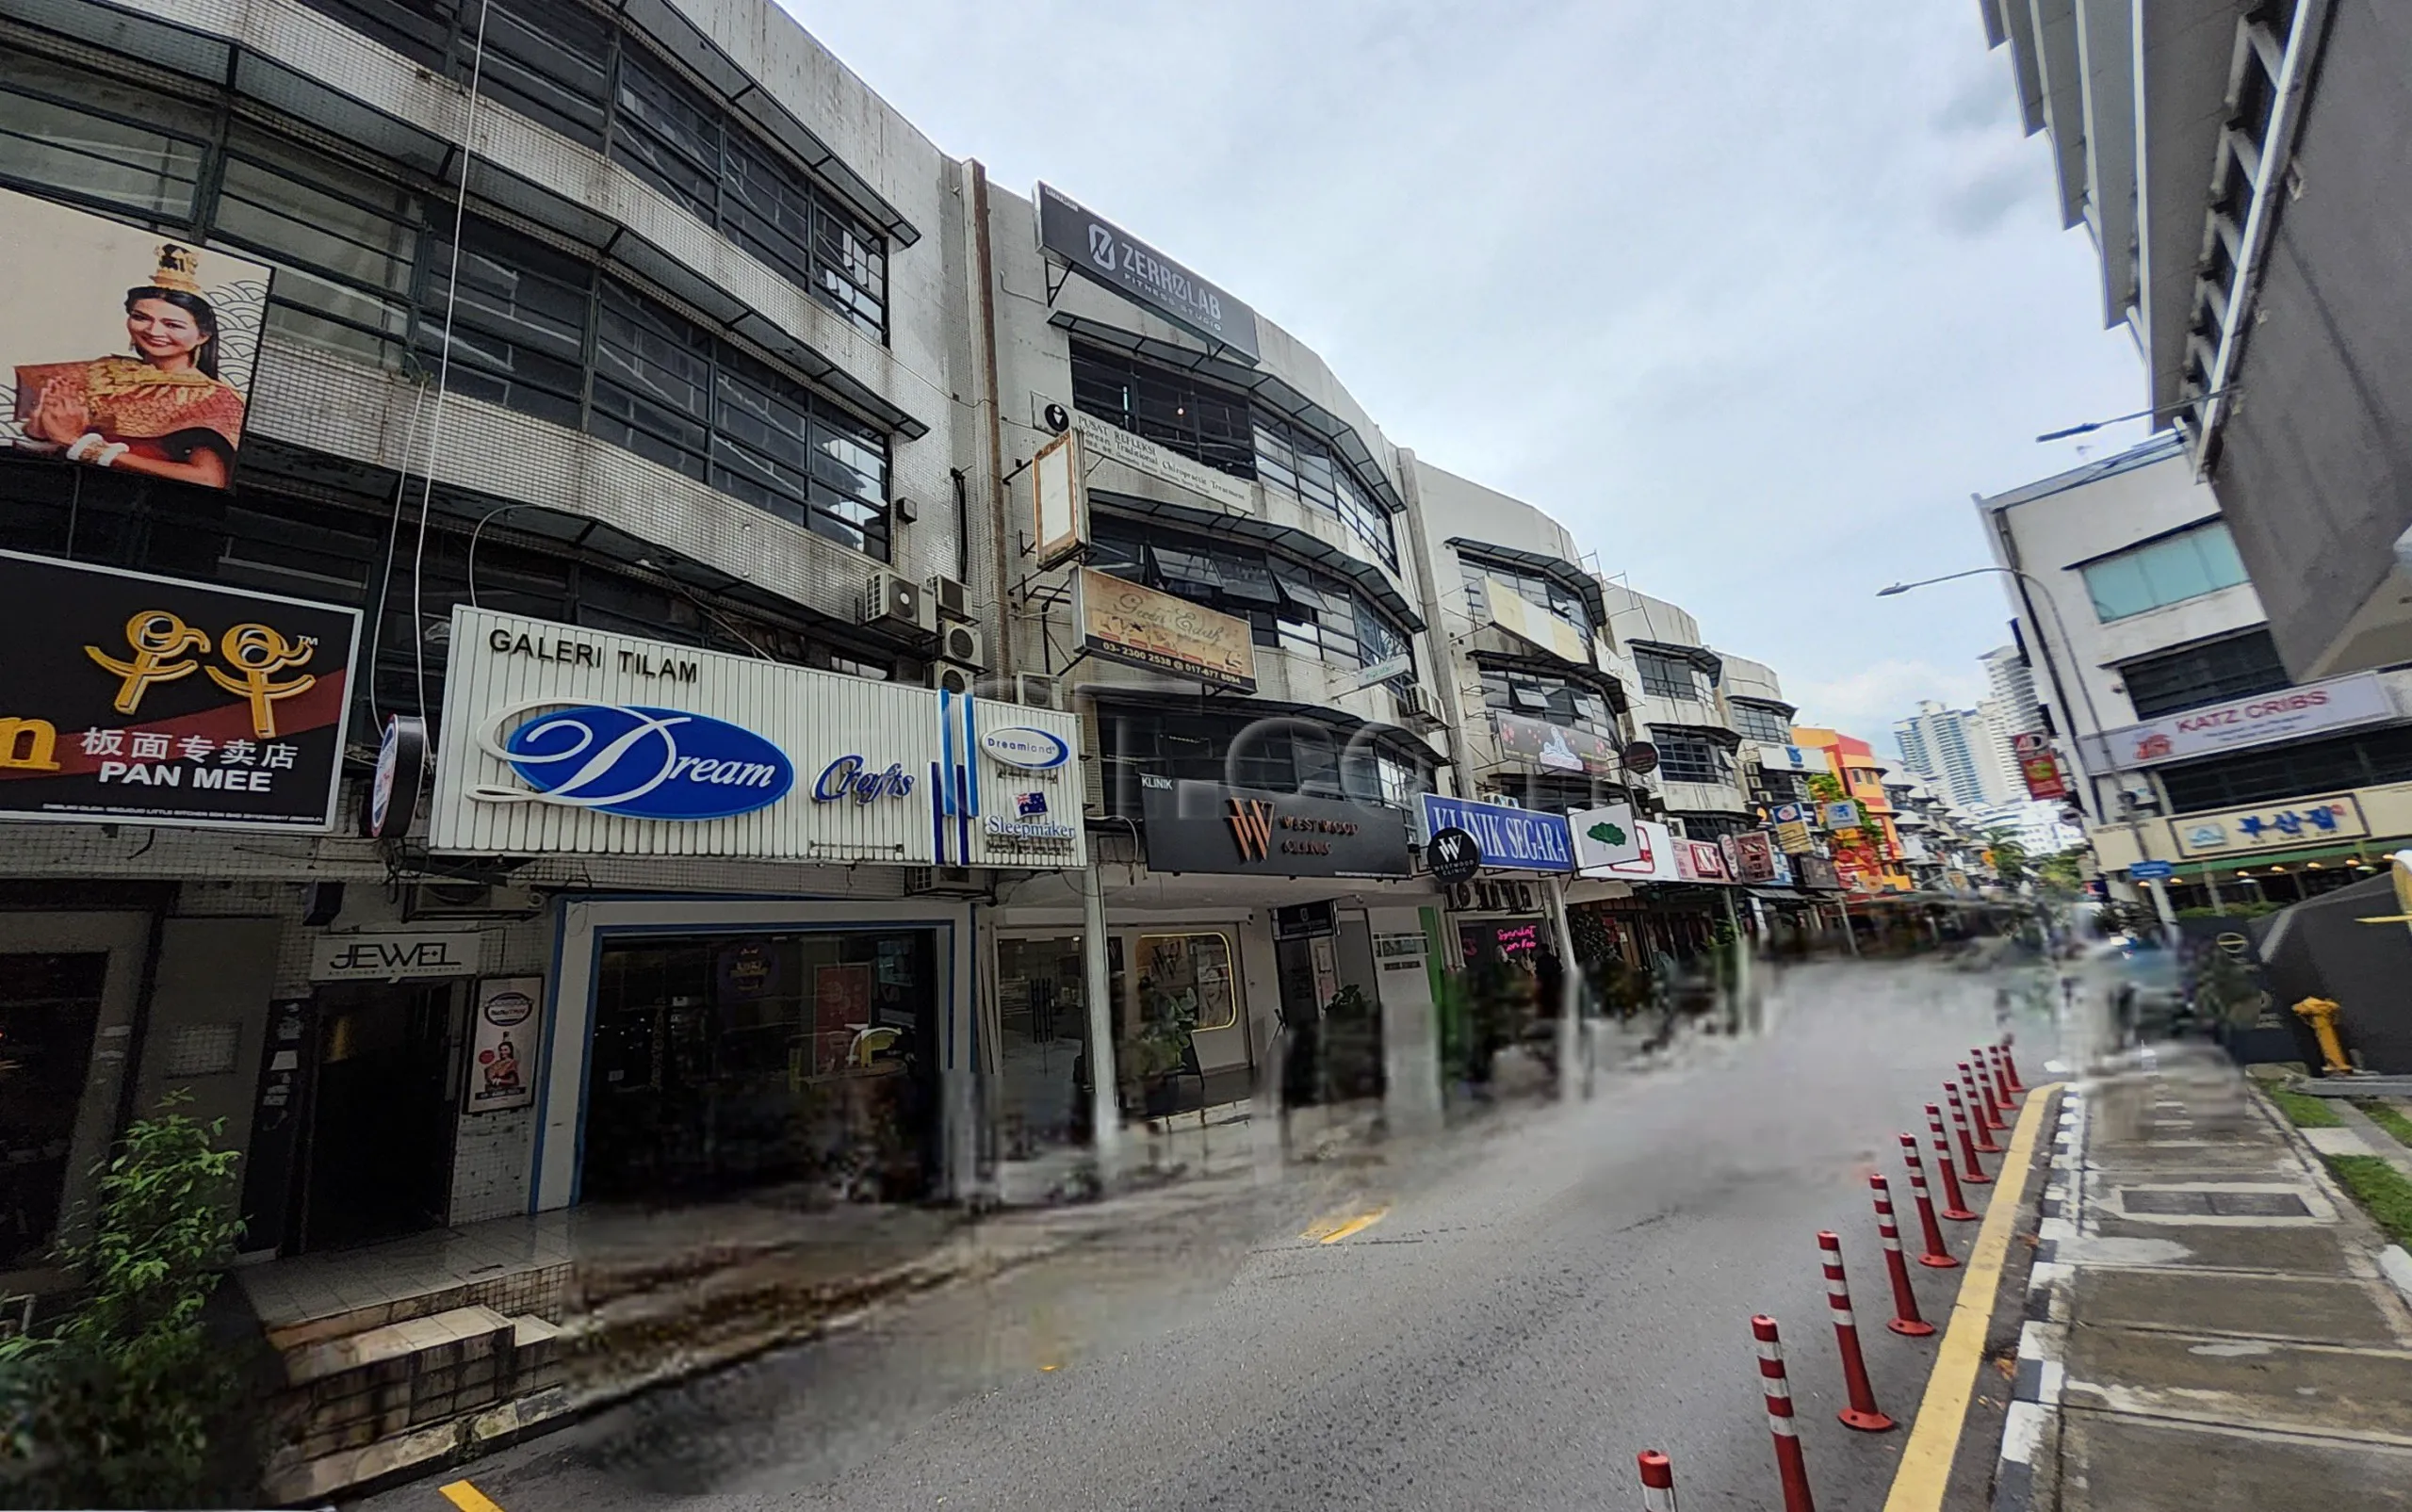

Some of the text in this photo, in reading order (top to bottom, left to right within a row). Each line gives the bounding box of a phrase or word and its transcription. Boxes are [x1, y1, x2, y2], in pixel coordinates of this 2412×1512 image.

[1124, 272, 1176, 306] FITNESS
[1180, 304, 1222, 331] STUDIO
[1077, 415, 1157, 456] PUSAT REFLEKSI
[1115, 438, 1159, 465] Traditional
[1162, 461, 1208, 485] Chiropractic
[1210, 480, 1246, 501] Treatment
[489, 627, 698, 684] GALERI TILAM
[1121, 646, 1146, 659] 2300
[2175, 709, 2243, 734] KATZ
[2243, 691, 2330, 719] CRIBS
[80, 726, 300, 770] 板面专卖店
[466, 697, 776, 807] Dream
[98, 760, 273, 793] PAN MEE
[810, 755, 915, 806] Crafts
[1141, 776, 1173, 791] KLINIK
[1507, 817, 1570, 863] SEGARA
[330, 943, 463, 969] JEWEL
